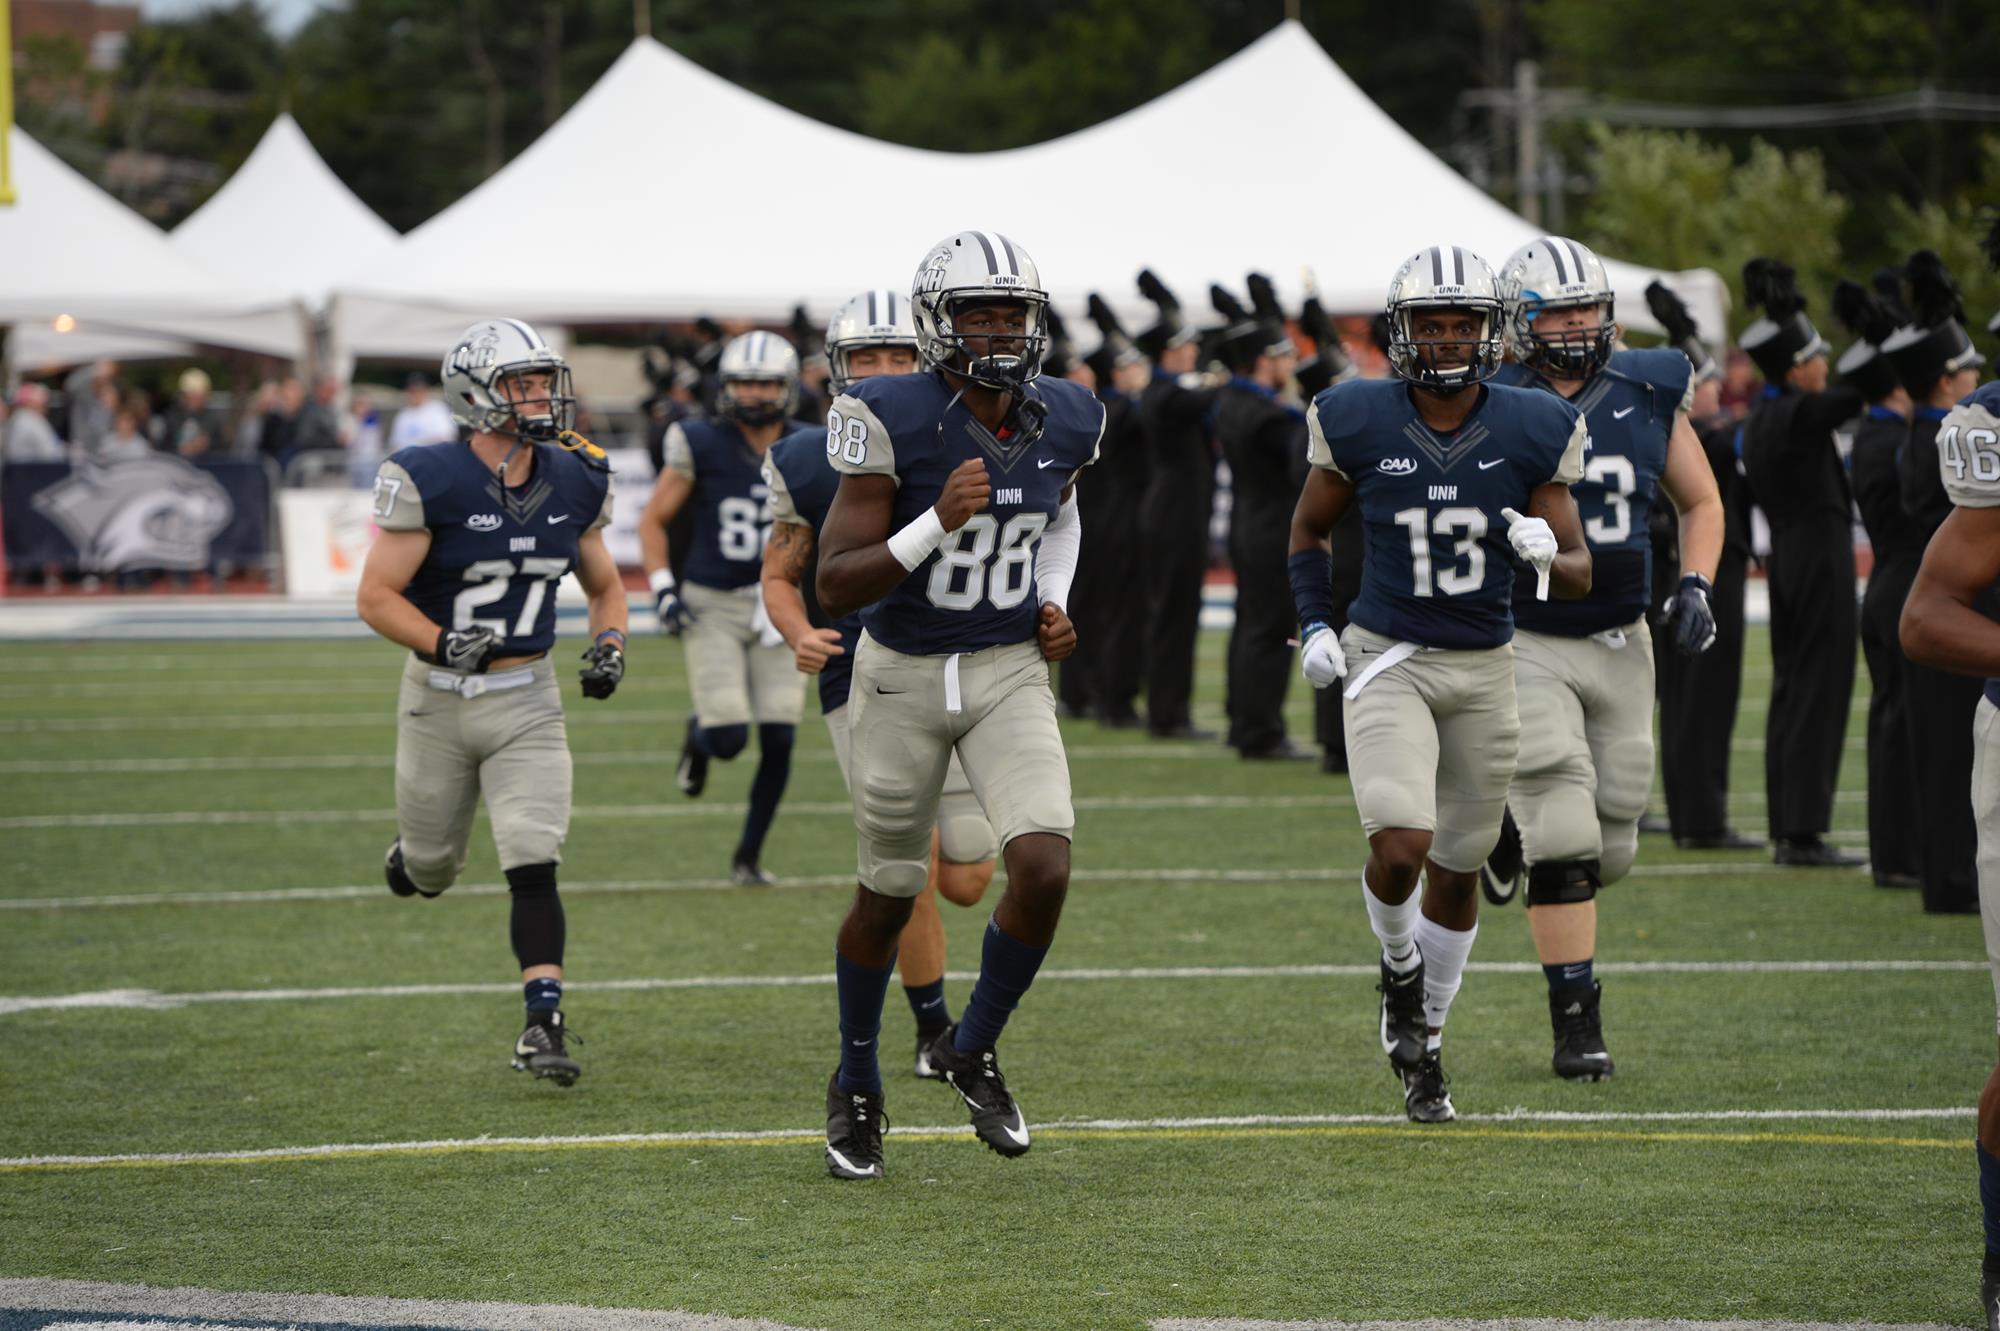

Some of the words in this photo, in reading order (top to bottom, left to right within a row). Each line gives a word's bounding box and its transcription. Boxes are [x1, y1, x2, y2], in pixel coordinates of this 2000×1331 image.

[995, 277, 1016, 285] UNH
[1438, 286, 1461, 294] UNH
[827, 408, 869, 466] 88
[1944, 425, 2000, 482] 46
[1380, 457, 1412, 472] CAA
[996, 488, 1023, 504] UNH
[1428, 485, 1458, 500] UNH
[1583, 454, 1637, 544] 3
[467, 513, 498, 528] CAA
[509, 536, 537, 552] UNH
[1394, 506, 1488, 598] 13
[926, 512, 1048, 611] 88
[453, 557, 570, 639] 27
